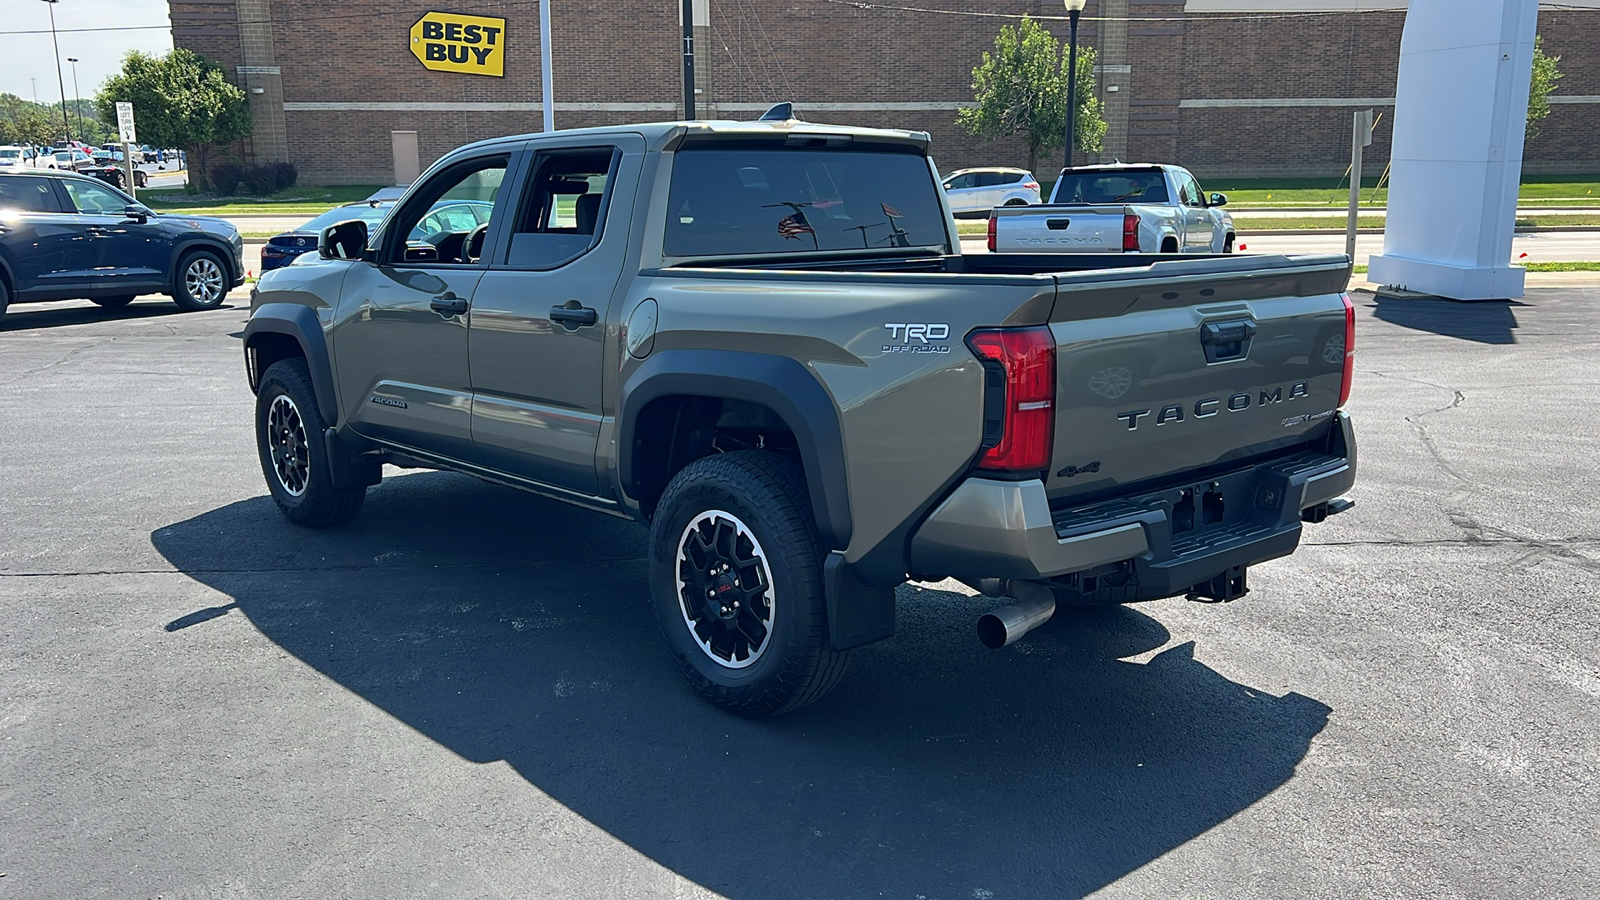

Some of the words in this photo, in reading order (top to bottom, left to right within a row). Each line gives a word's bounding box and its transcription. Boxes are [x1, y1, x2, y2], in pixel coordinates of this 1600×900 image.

[422, 21, 501, 46] BEST
[425, 43, 494, 66] BUY
[1015, 237, 1102, 245] TACOMA
[884, 323, 950, 344] TRD
[881, 345, 909, 354] OFF
[910, 345, 951, 354] ROAD
[369, 396, 407, 409] TACOMA
[1117, 381, 1309, 431] TACOMA
